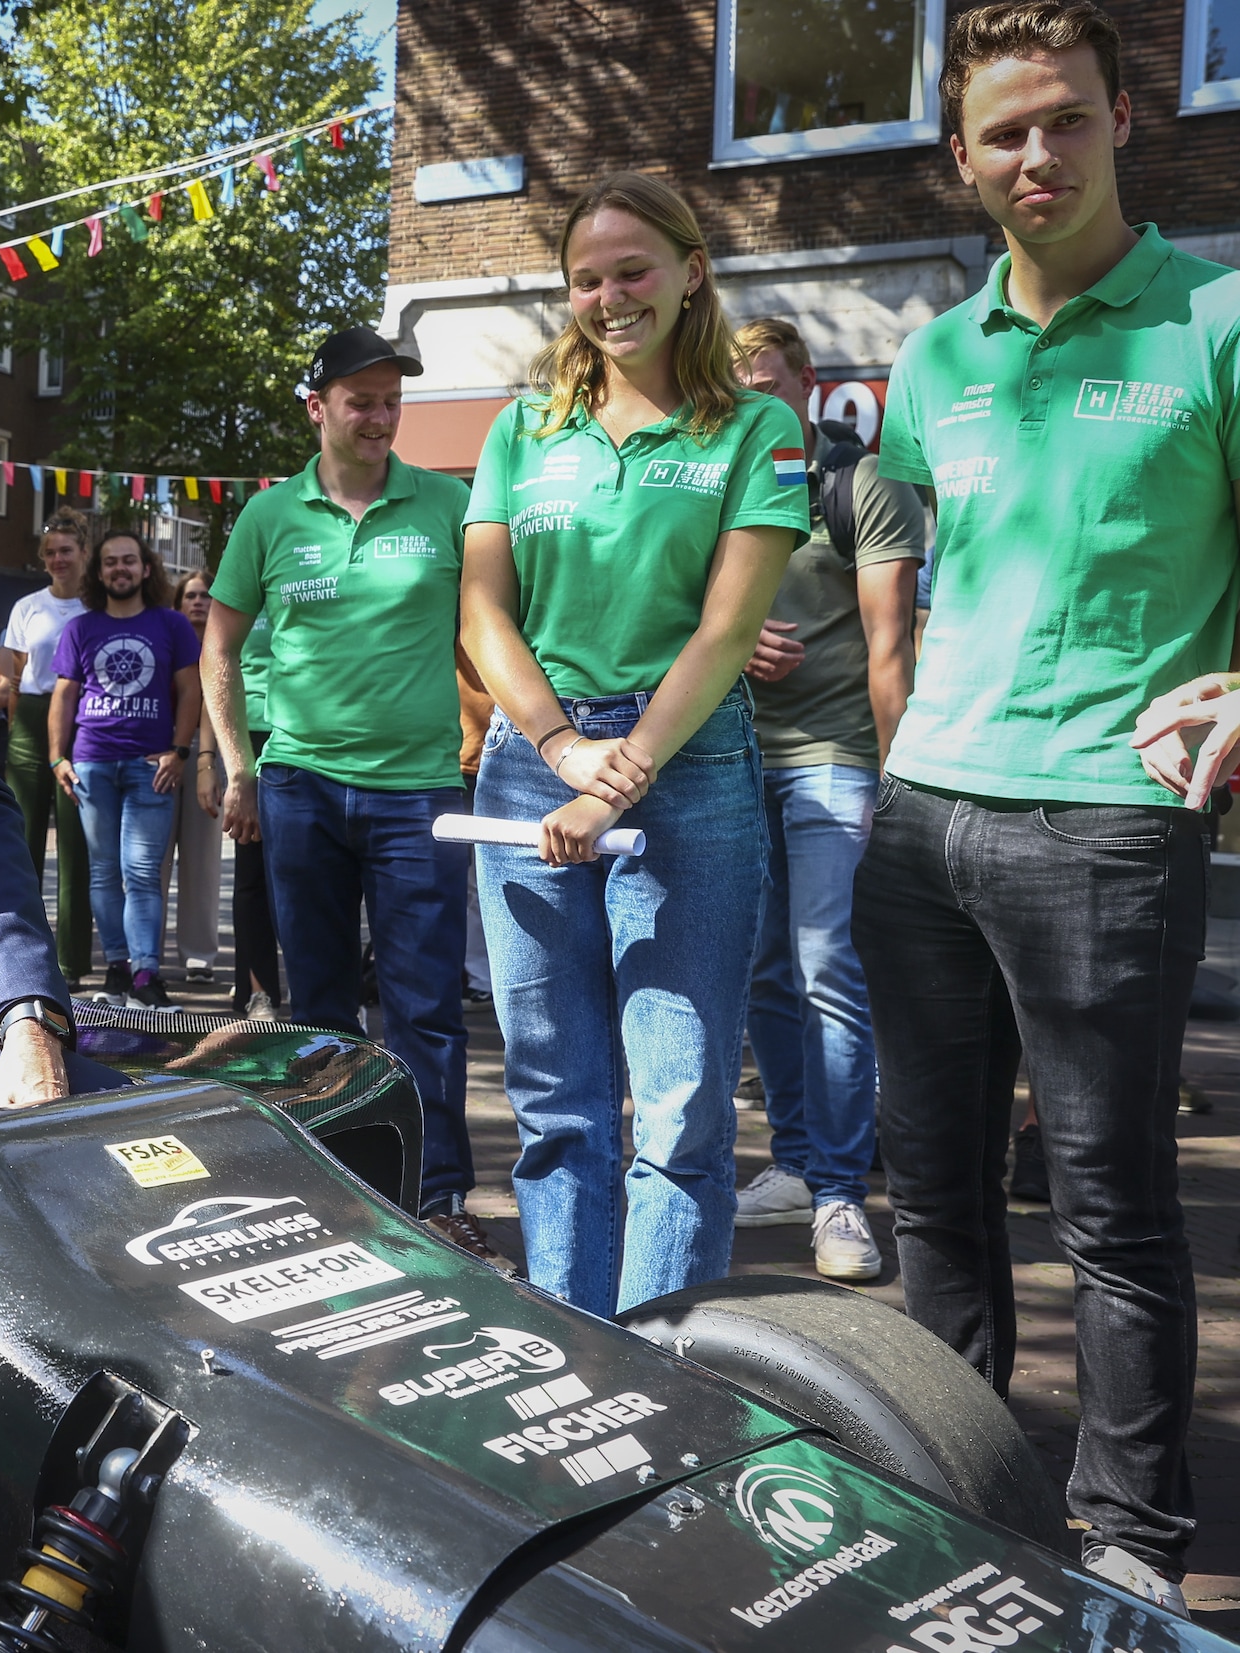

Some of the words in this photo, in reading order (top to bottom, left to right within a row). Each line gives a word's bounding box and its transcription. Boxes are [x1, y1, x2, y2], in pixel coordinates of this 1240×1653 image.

[1125, 381, 1185, 398] GREEN
[1122, 392, 1175, 407] TEAM
[1122, 403, 1193, 422] TWENTE
[1116, 416, 1159, 426] HYDROGEN
[1161, 421, 1190, 431] RACING
[682, 469, 722, 480] TEAM
[685, 461, 730, 473] GREEN
[675, 484, 709, 494] HYDROGEN
[680, 476, 727, 491] TWENT
[509, 499, 579, 531] UNIVERSITY
[520, 514, 576, 539] TWENTE.
[280, 576, 339, 595] UNIVERSITY
[281, 594, 292, 606] OF
[293, 588, 340, 603] TWENTE.
[117, 1141, 182, 1162] FSAS
[158, 1212, 322, 1262] GEERLINGS
[179, 1228, 334, 1271] AUTOSCHADE
[225, 1266, 388, 1315] TECHNOLOGIES
[733, 1346, 771, 1365] SAFETY
[378, 1350, 522, 1406] SUPER
[482, 1391, 668, 1464] FISCHER
[888, 1602, 920, 1622] the
[947, 1561, 1002, 1593] company
